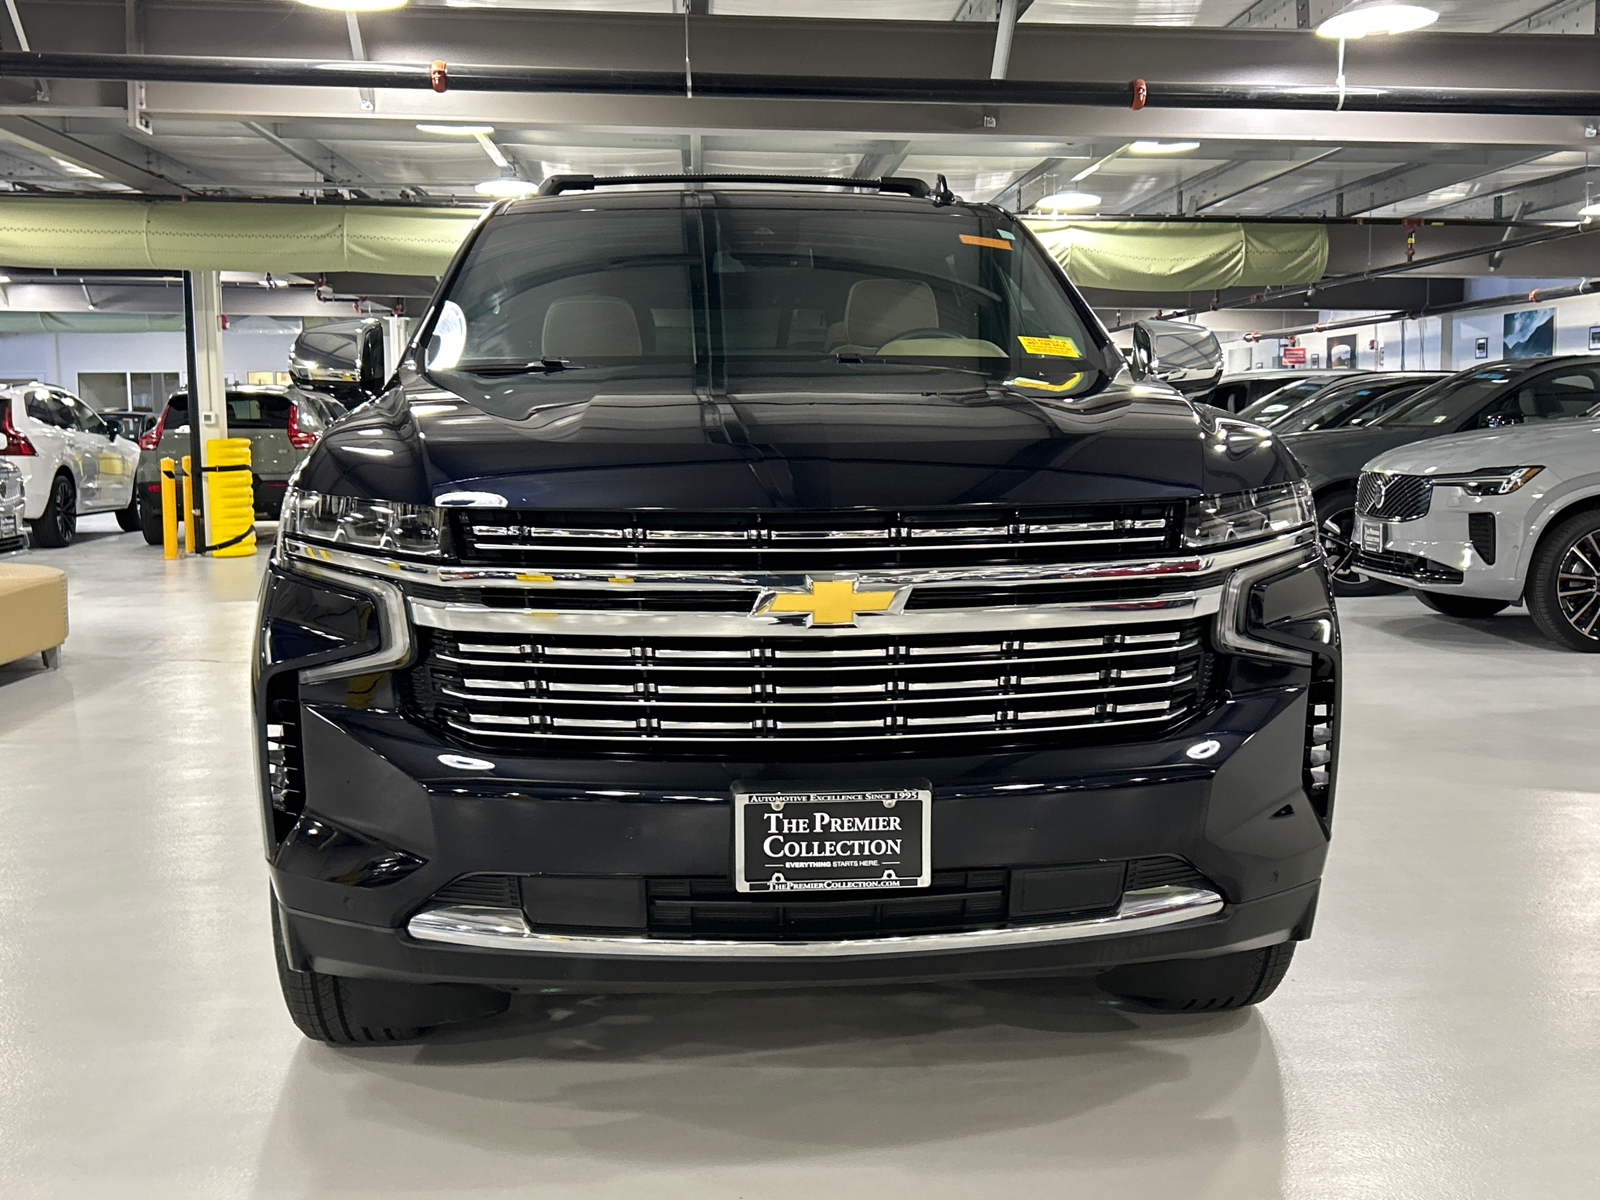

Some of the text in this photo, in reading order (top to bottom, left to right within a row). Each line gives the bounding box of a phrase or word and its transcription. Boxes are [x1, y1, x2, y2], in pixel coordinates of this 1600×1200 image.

[750, 795, 808, 803] AUTOMOTIVE
[810, 794, 864, 802] EXCELLENCE
[894, 792, 918, 800] 1995
[764, 812, 902, 834] THE PREMIER
[763, 835, 902, 858] COLLECTION
[767, 880, 900, 890] THEPREMIERCOLLECTION.COM
